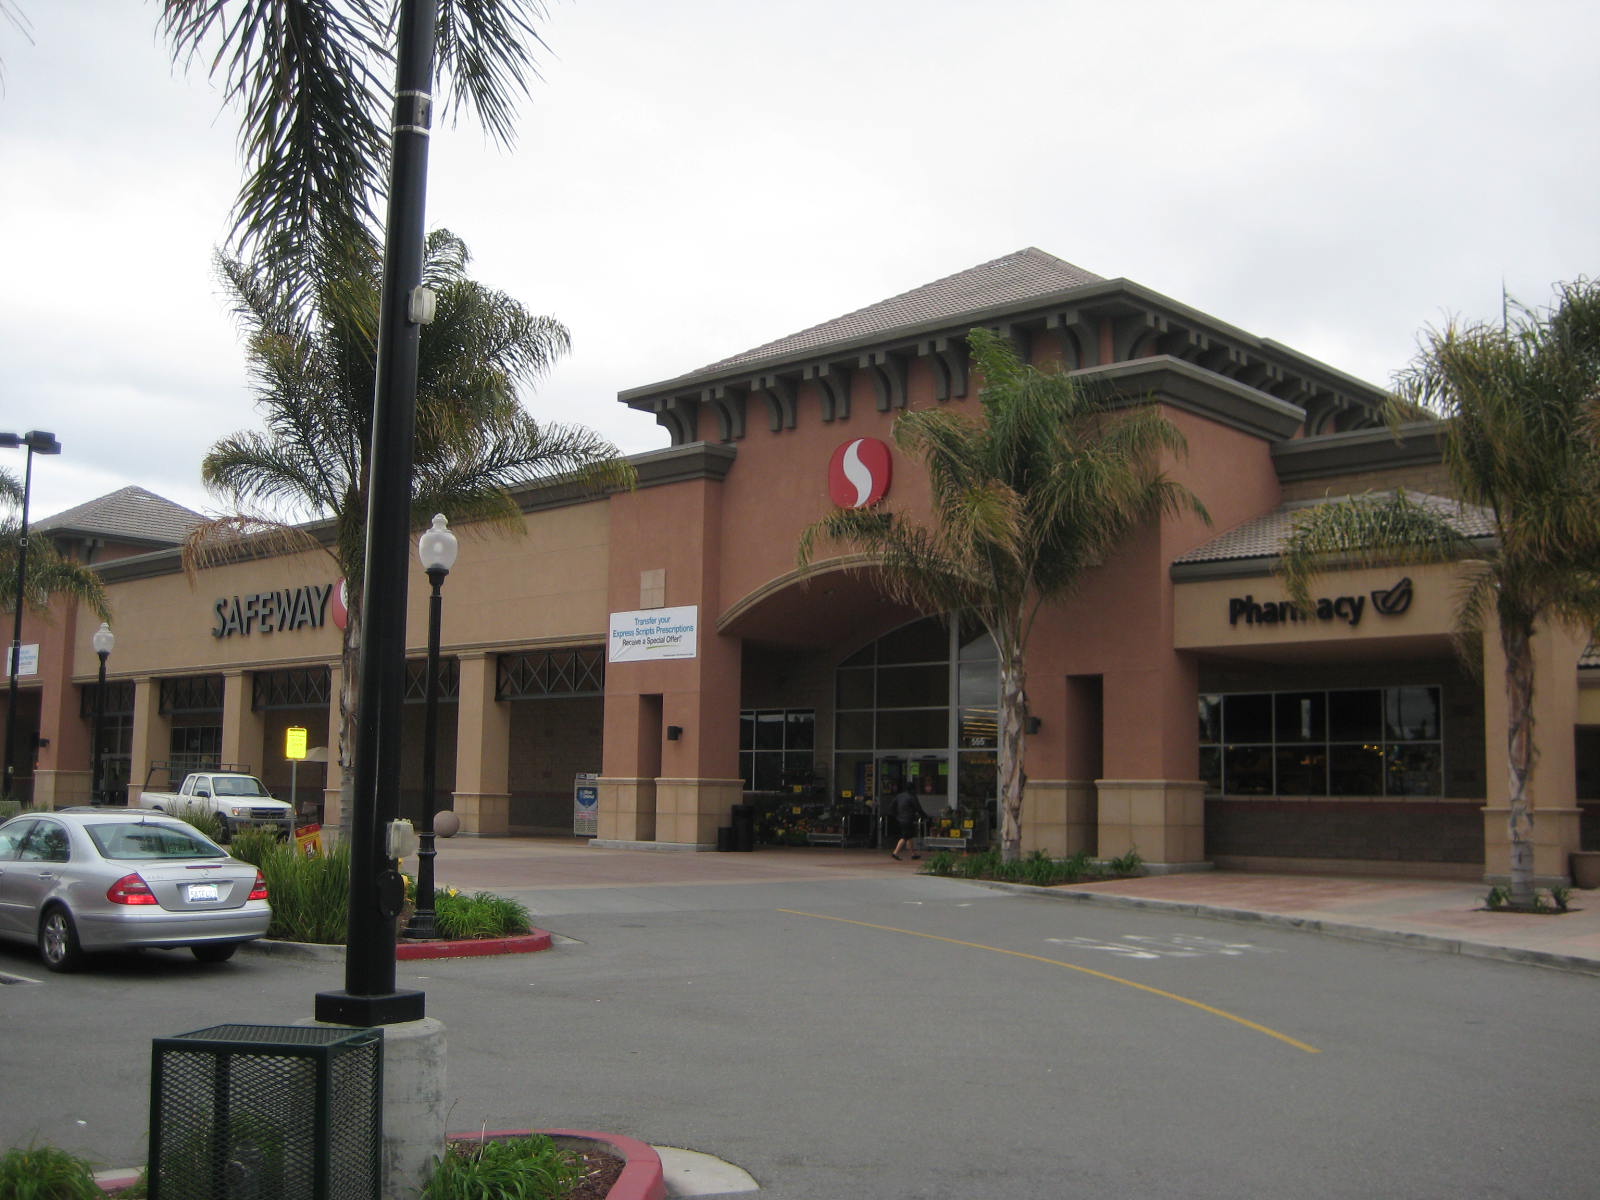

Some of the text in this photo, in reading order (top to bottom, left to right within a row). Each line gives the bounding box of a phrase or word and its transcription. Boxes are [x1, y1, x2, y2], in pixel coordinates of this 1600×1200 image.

[211, 583, 333, 639] SAFEWAY
[635, 616, 670, 625] Transfer your
[613, 625, 693, 639] Express Scripts Prescriptions
[646, 636, 666, 646] Special
